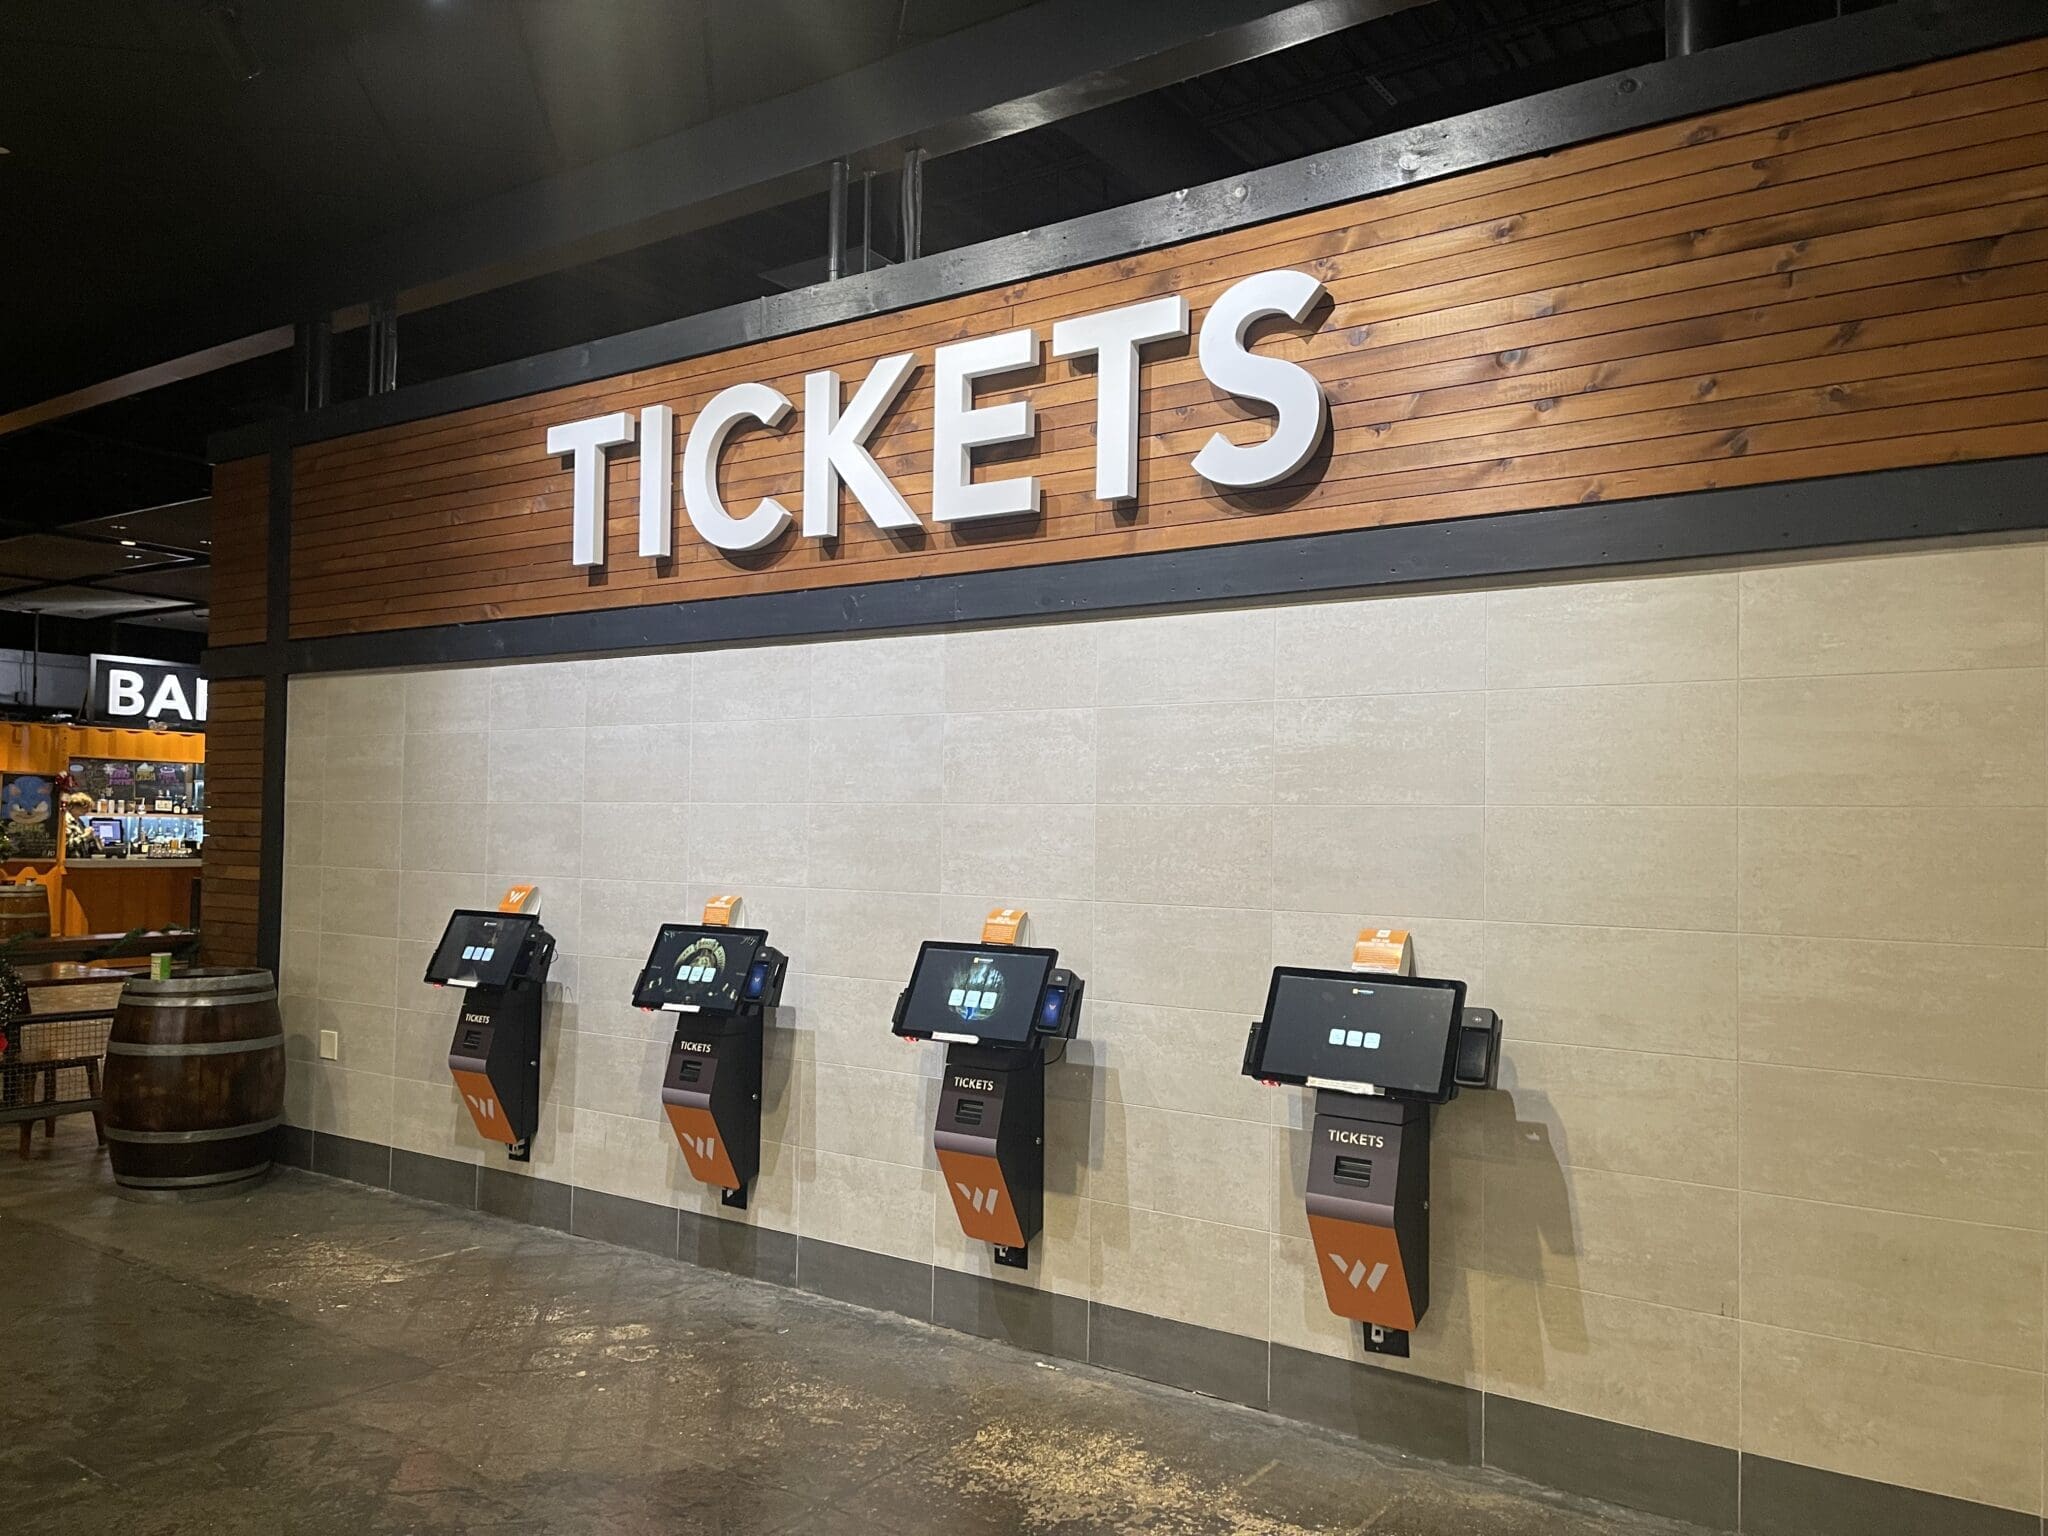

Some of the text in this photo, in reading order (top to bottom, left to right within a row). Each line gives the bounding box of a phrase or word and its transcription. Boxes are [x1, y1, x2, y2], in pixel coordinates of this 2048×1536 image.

[546, 270, 1327, 567] TICKETS
[465, 1013, 490, 1024] TICKETS
[681, 1040, 712, 1053] TICKETS
[954, 1076, 994, 1091] TICKETS
[1328, 1129, 1384, 1148] TICKETS
